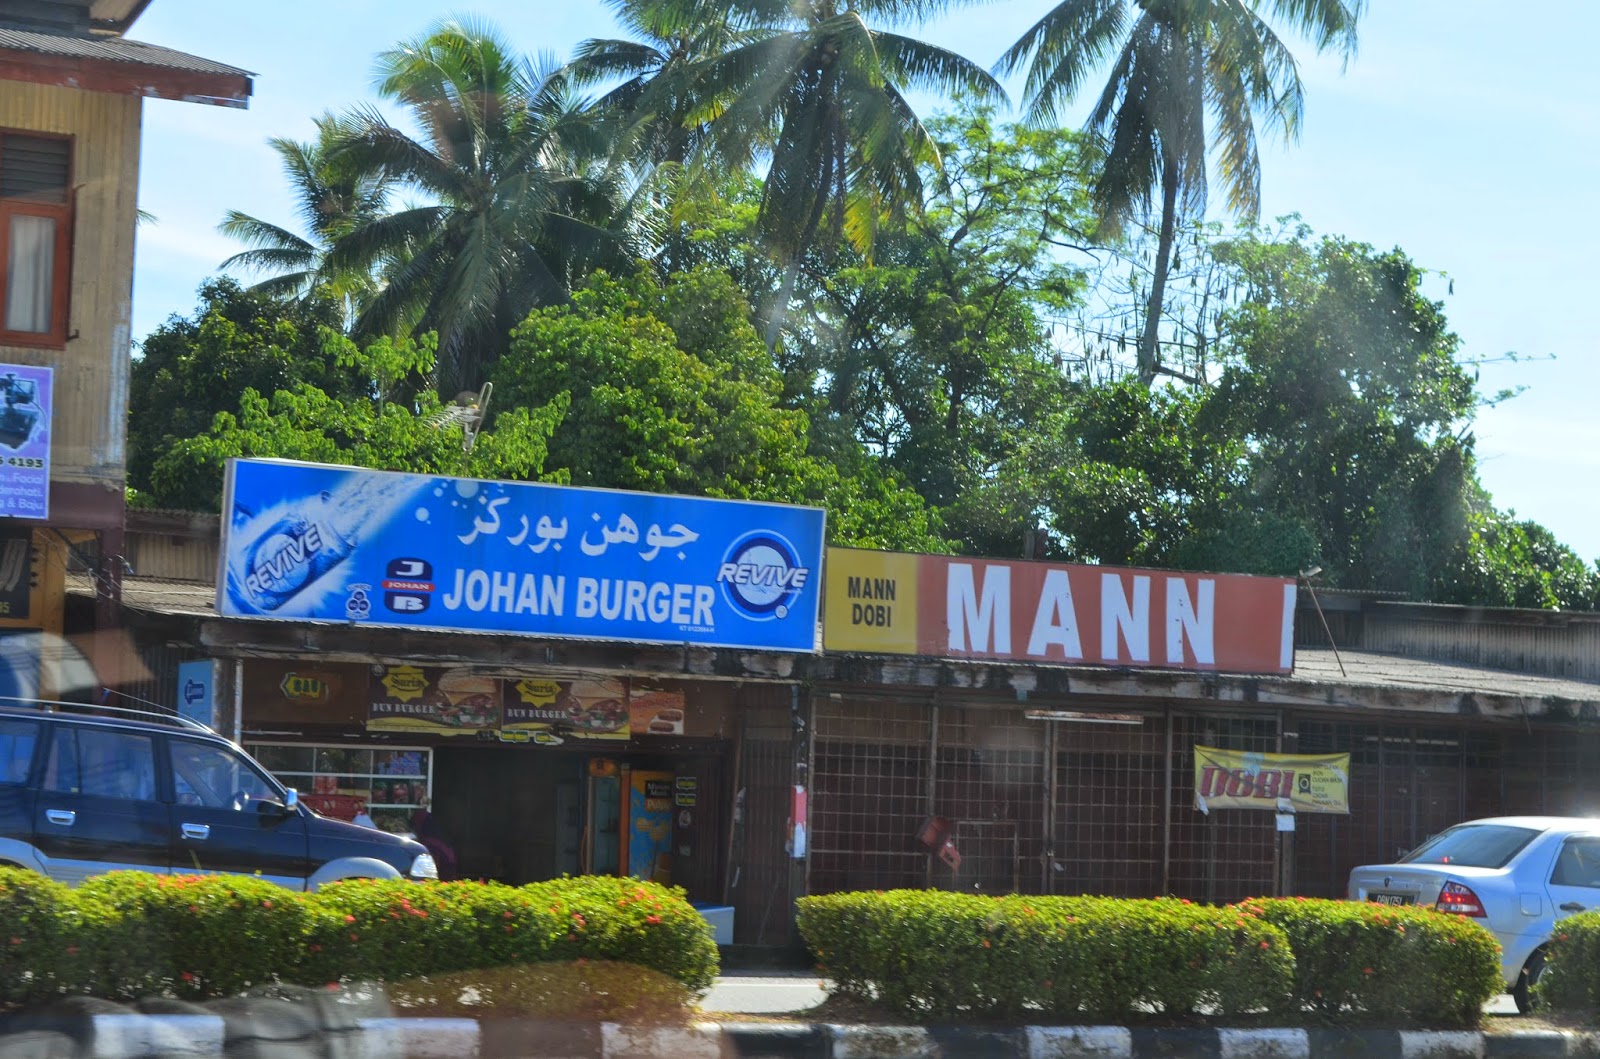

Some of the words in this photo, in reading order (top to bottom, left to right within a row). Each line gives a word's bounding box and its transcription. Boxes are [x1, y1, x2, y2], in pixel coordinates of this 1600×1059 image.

[7, 456, 44, 469] 4193
[245, 522, 324, 599] REVIVE
[387, 581, 430, 591] JOHAN
[716, 562, 810, 589] REVIVE
[443, 568, 565, 617] JOHAN
[575, 577, 715, 627] BURGER
[847, 576, 897, 601] MANN
[852, 603, 892, 628] DOBI
[947, 562, 1216, 666] MANN
[372, 703, 392, 712] BUN
[394, 704, 436, 714] BURGER
[507, 708, 526, 718] BUN
[528, 709, 568, 719] BURGER
[1201, 765, 1296, 799] DOBI
